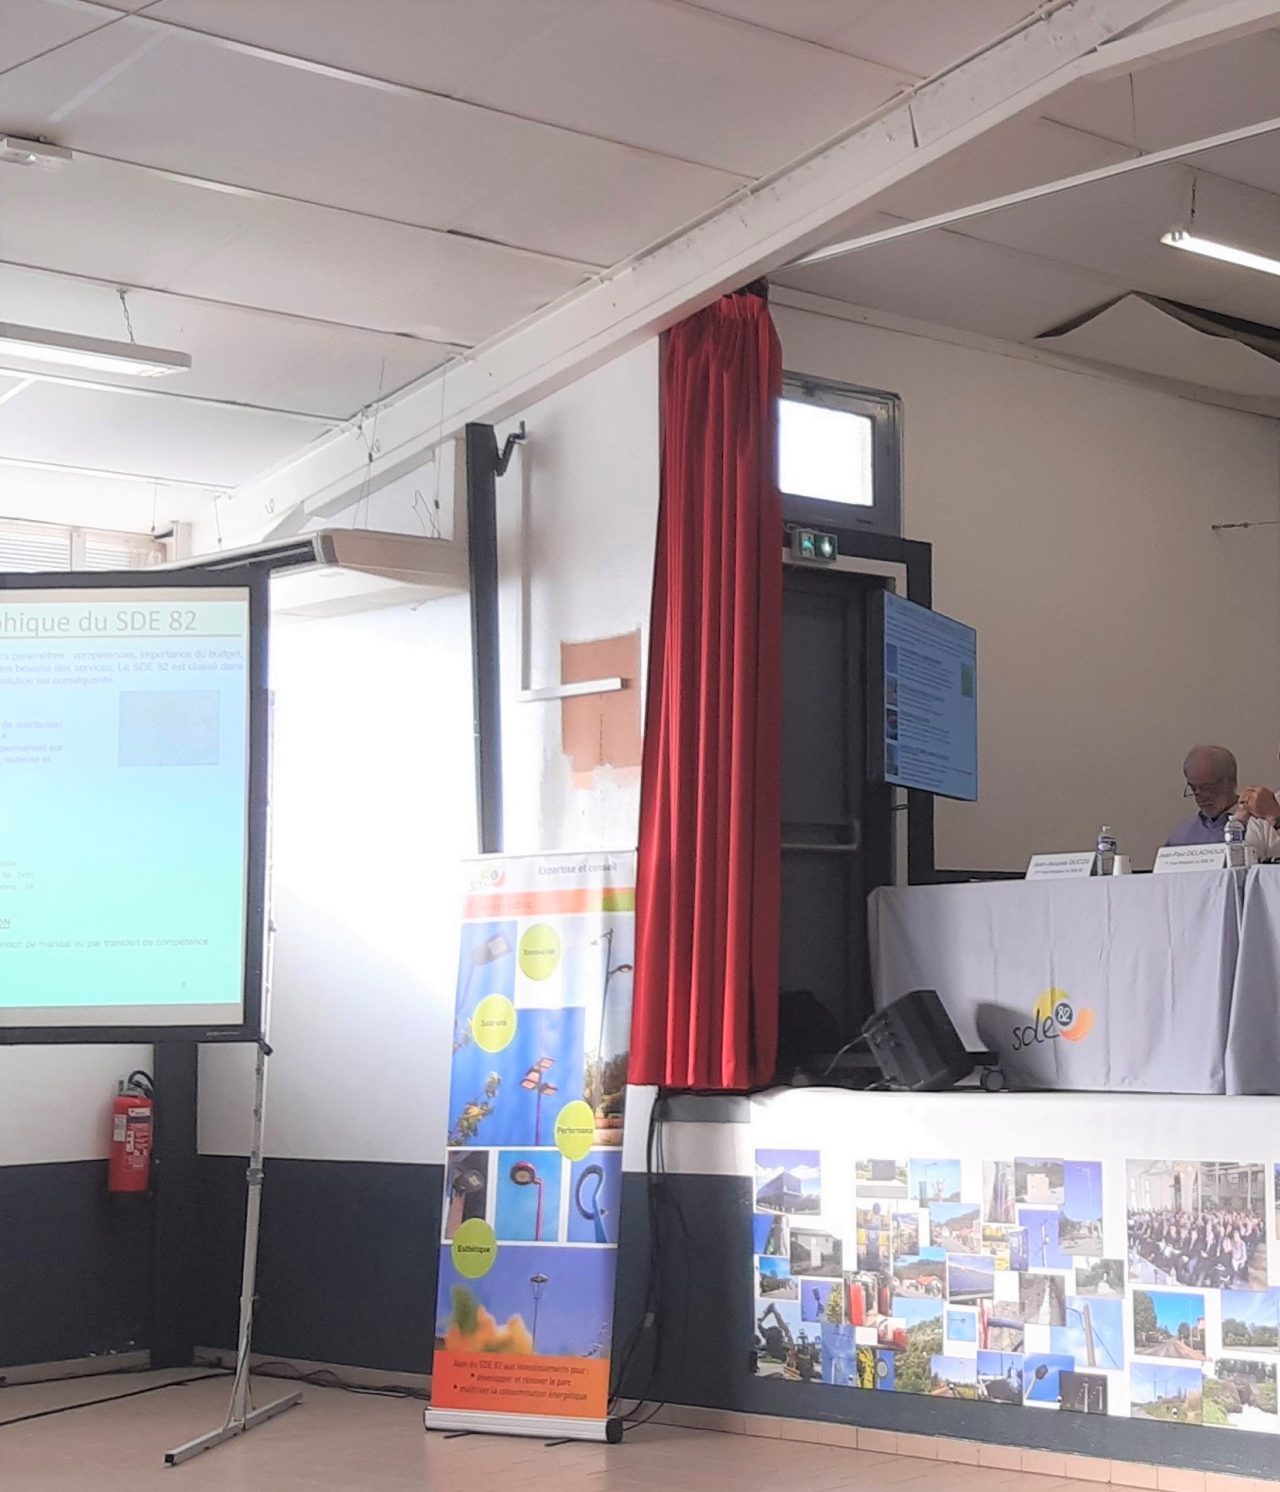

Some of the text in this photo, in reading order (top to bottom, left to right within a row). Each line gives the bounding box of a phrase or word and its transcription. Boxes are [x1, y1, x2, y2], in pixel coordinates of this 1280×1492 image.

[0, 610, 197, 636] hique du SDE 82
[538, 864, 576, 875] Expertise
[578, 864, 587, 873] et
[1012, 1005, 1071, 1051] sde 82
